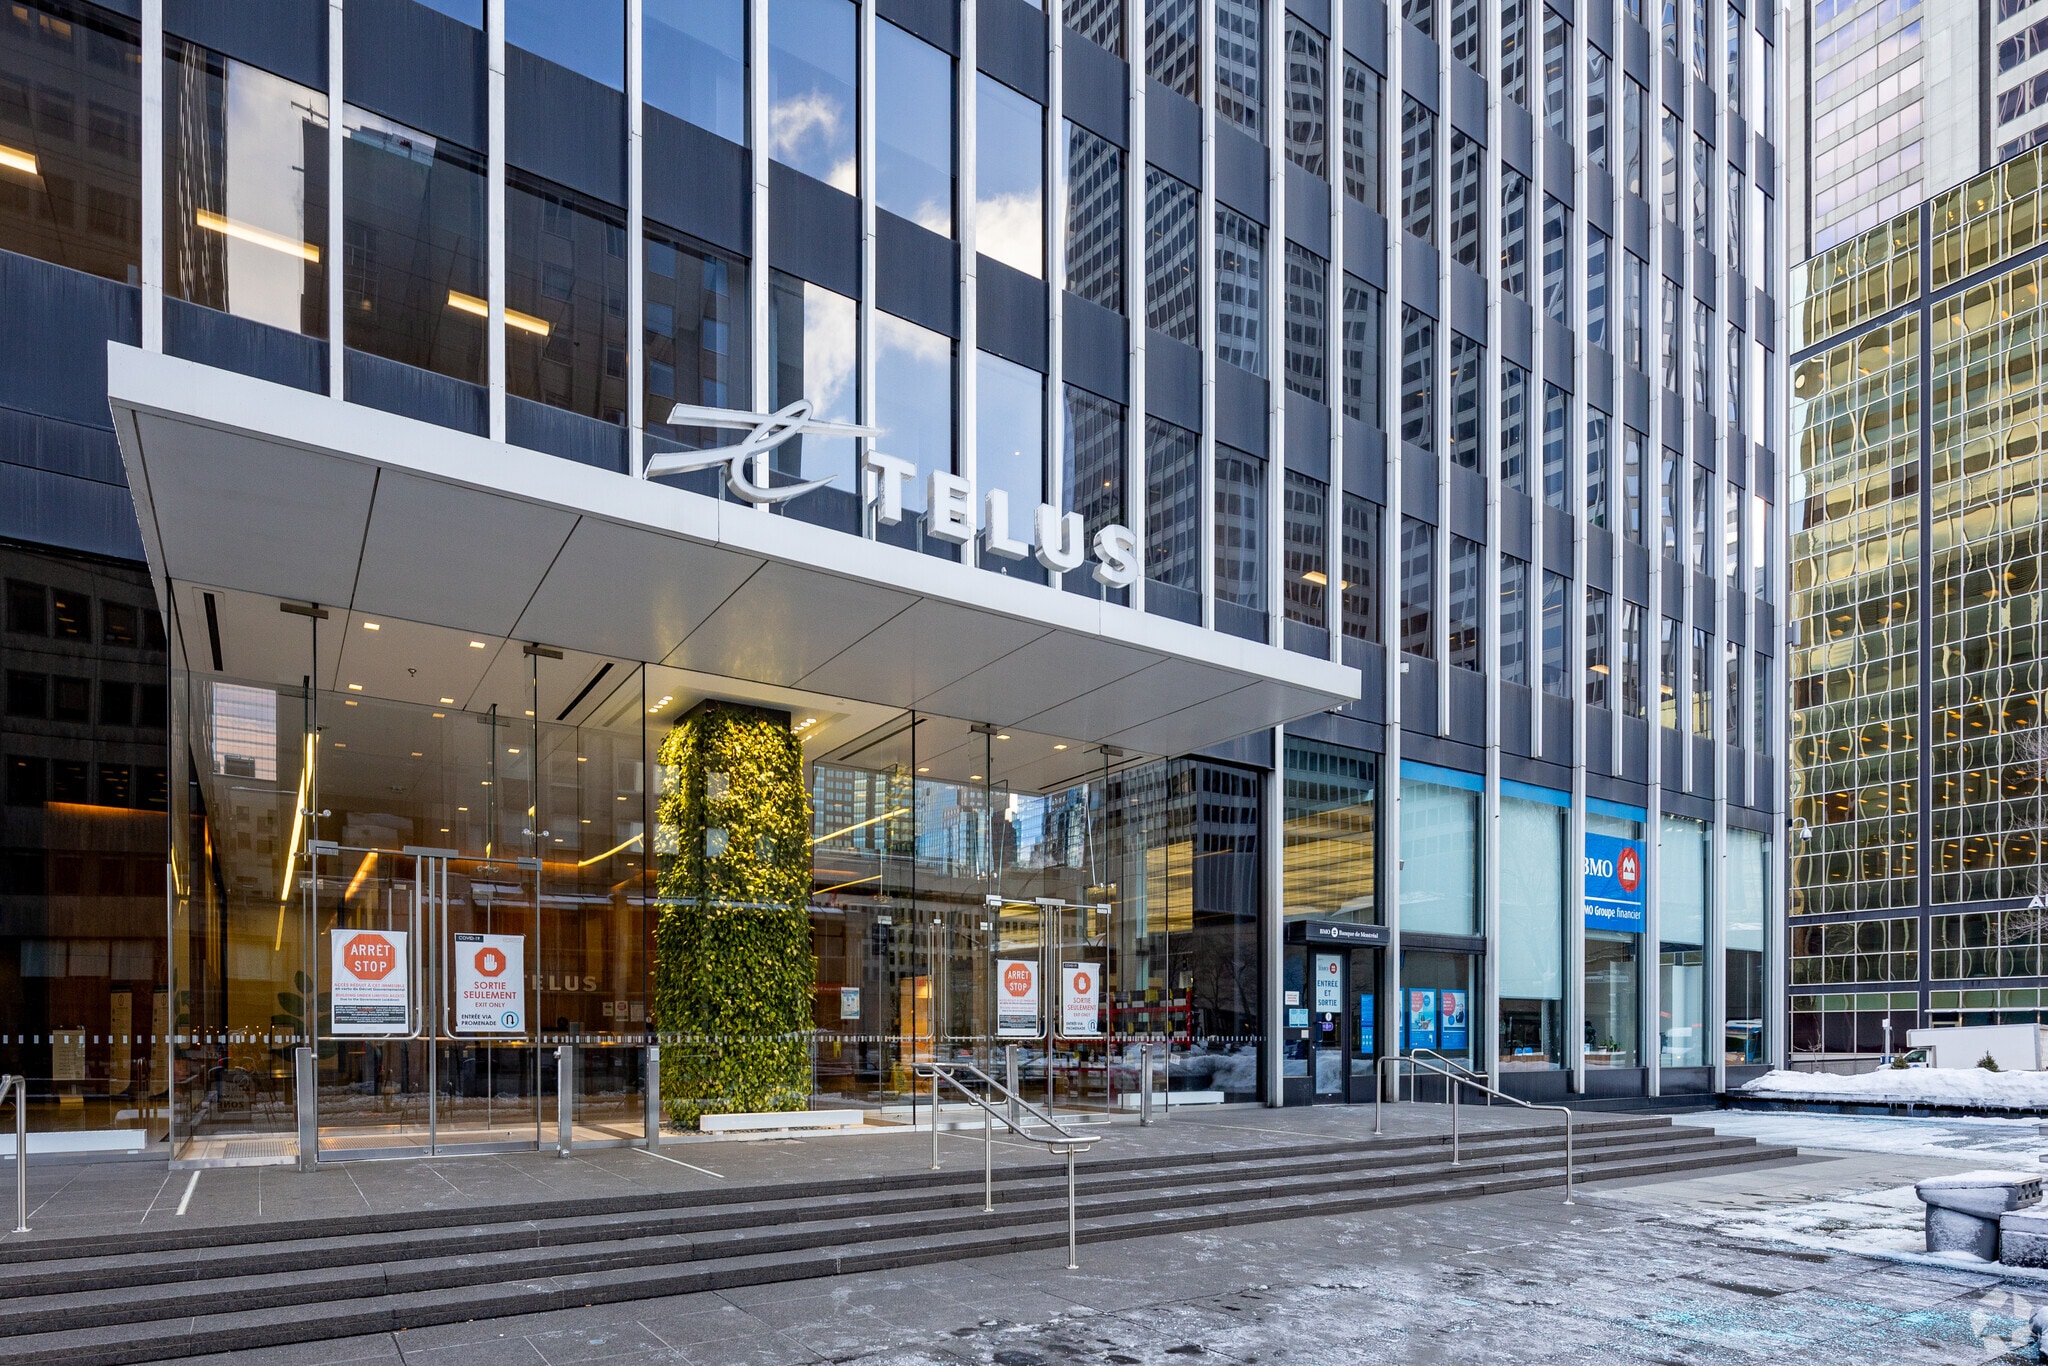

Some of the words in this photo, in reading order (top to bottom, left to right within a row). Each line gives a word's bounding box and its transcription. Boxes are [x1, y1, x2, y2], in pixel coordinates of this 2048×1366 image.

[862, 449, 1140, 589] TELUS
[1594, 905, 1615, 919] Groupe
[1616, 907, 1641, 920] financier
[1339, 930, 1355, 938] Banque
[351, 943, 390, 956] ARRÊT
[354, 960, 387, 972] STOP
[474, 981, 506, 990] SORTIE
[524, 974, 597, 992] ELUS
[1009, 982, 1028, 992] STOP
[1317, 979, 1339, 988] ENTRÉE
[463, 991, 517, 1000] SEULEMENT
[1324, 989, 1332, 997] ET
[1318, 999, 1337, 1007] SORTIE
